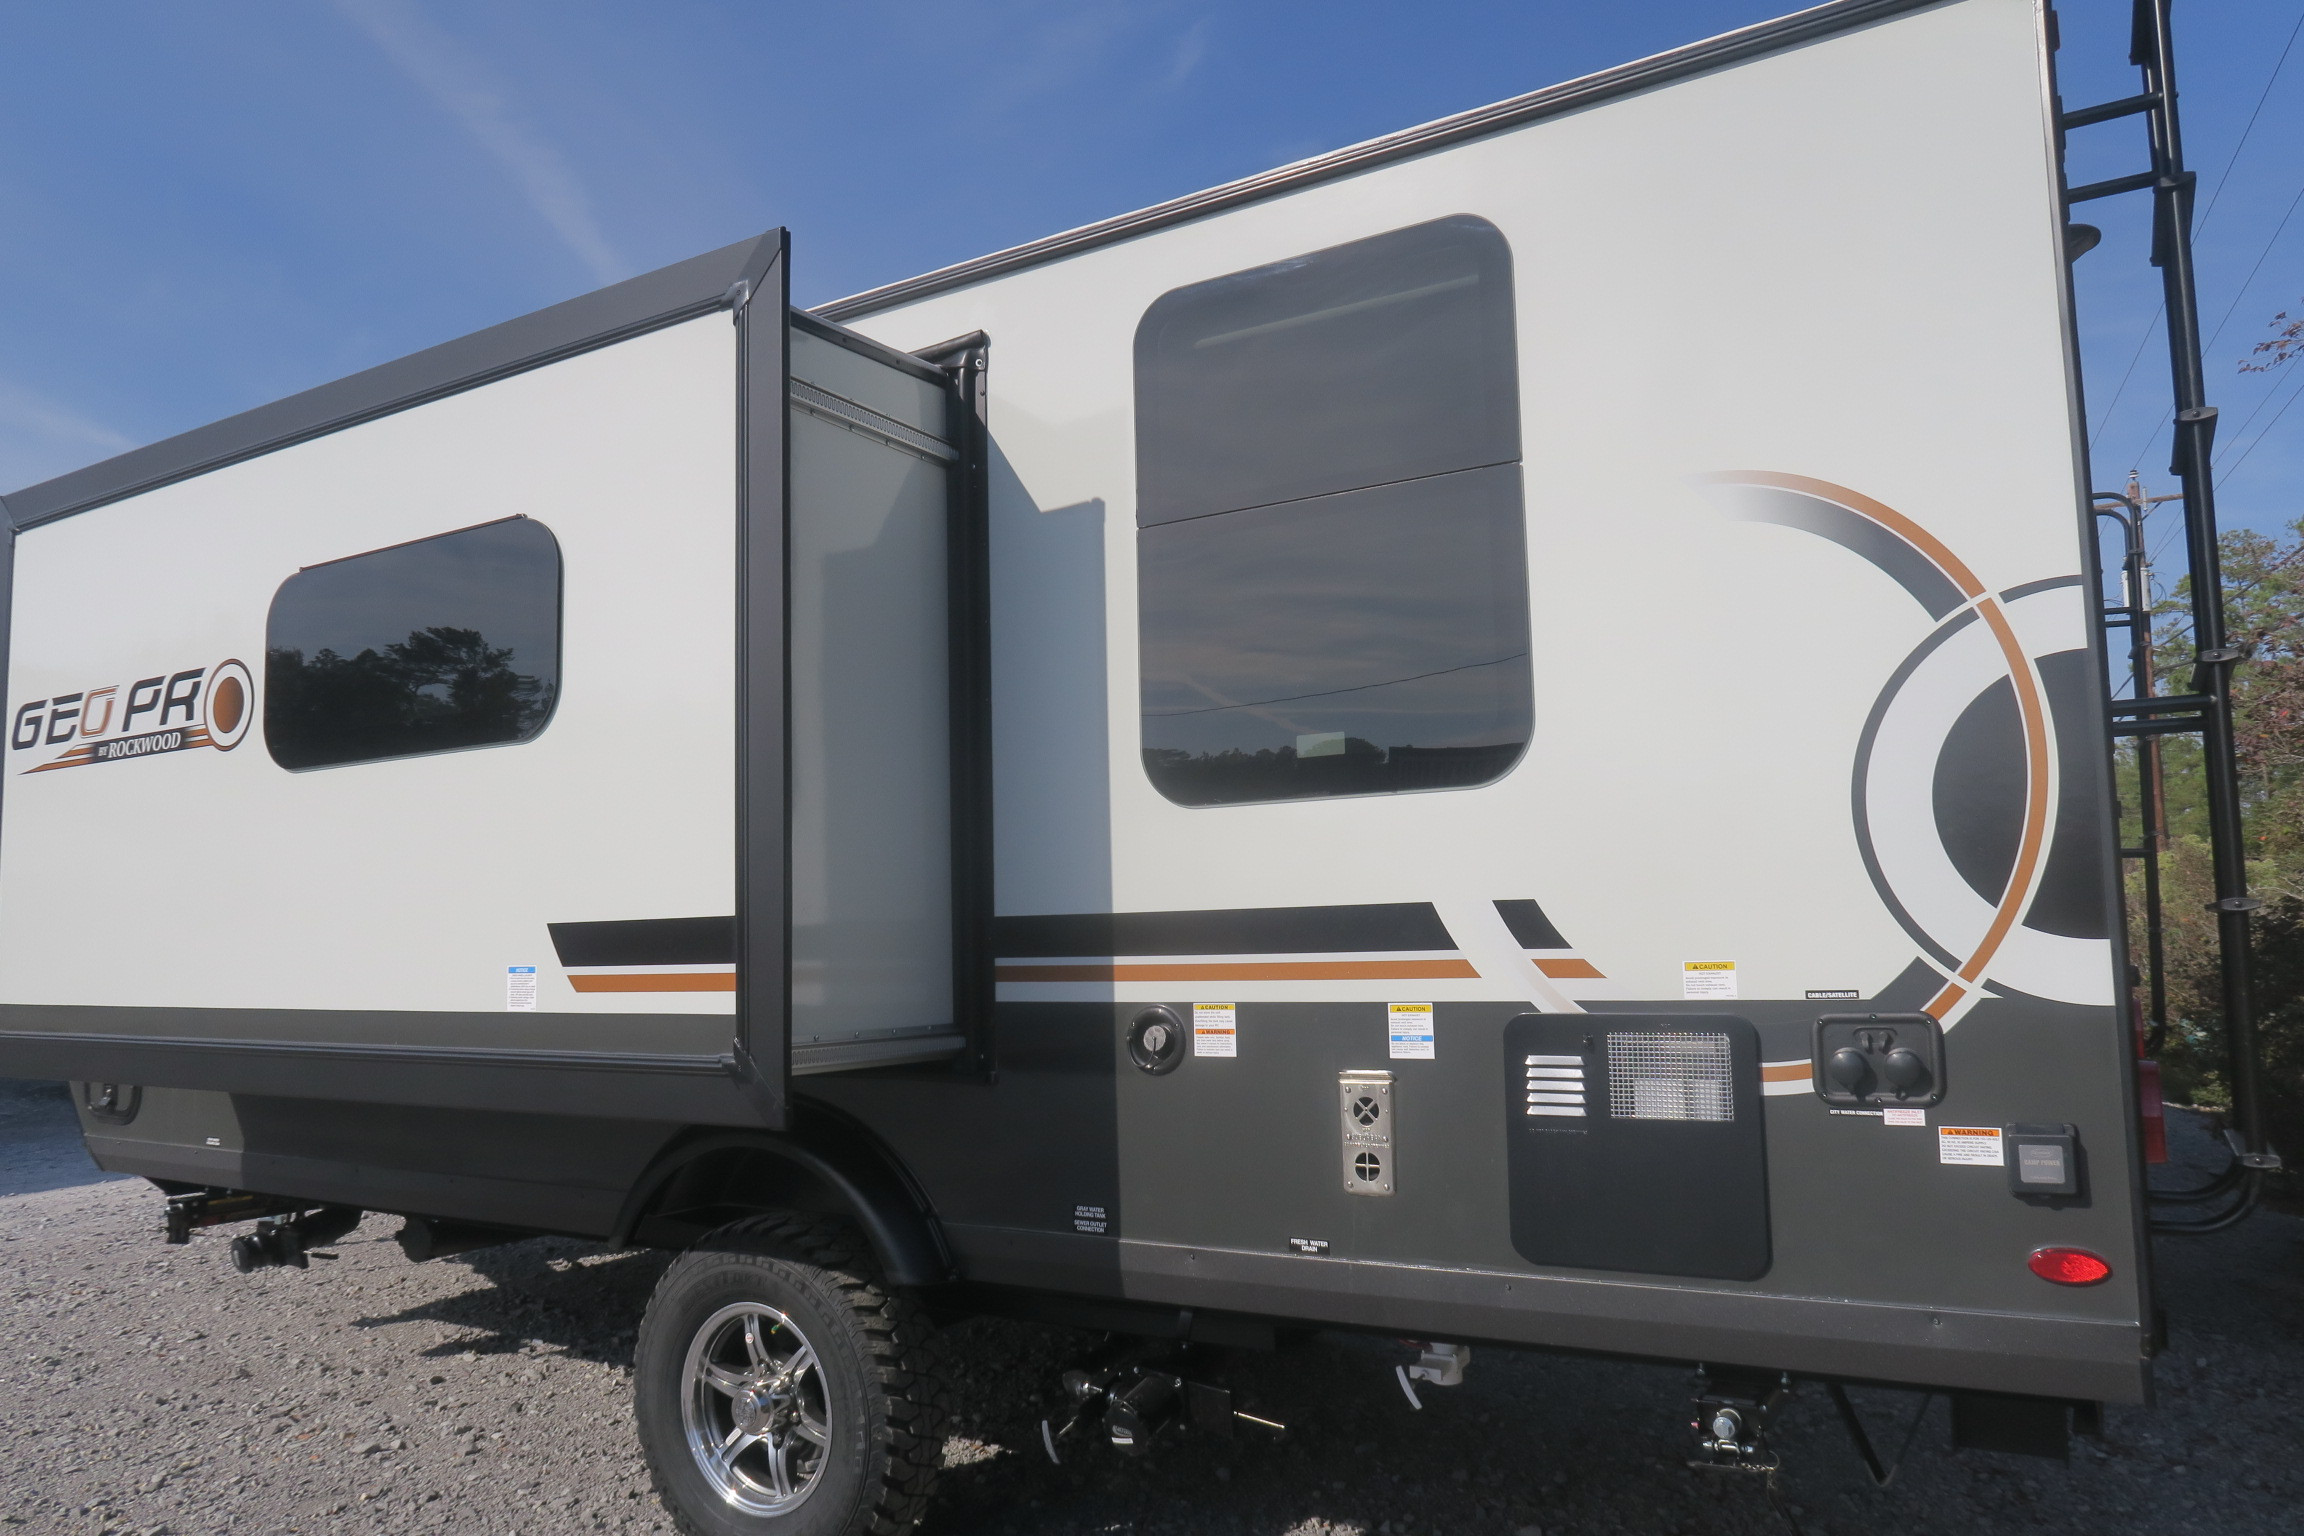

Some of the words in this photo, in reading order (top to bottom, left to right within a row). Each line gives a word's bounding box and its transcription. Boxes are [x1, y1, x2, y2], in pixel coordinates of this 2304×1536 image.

[12, 684, 120, 751] GEO
[107, 731, 182, 759] ROCKWOOD
[1807, 991, 1858, 999] CABLE/SATELLITE
[1290, 1238, 1309, 1246] FRESH
[1309, 1239, 1329, 1248] WATER
